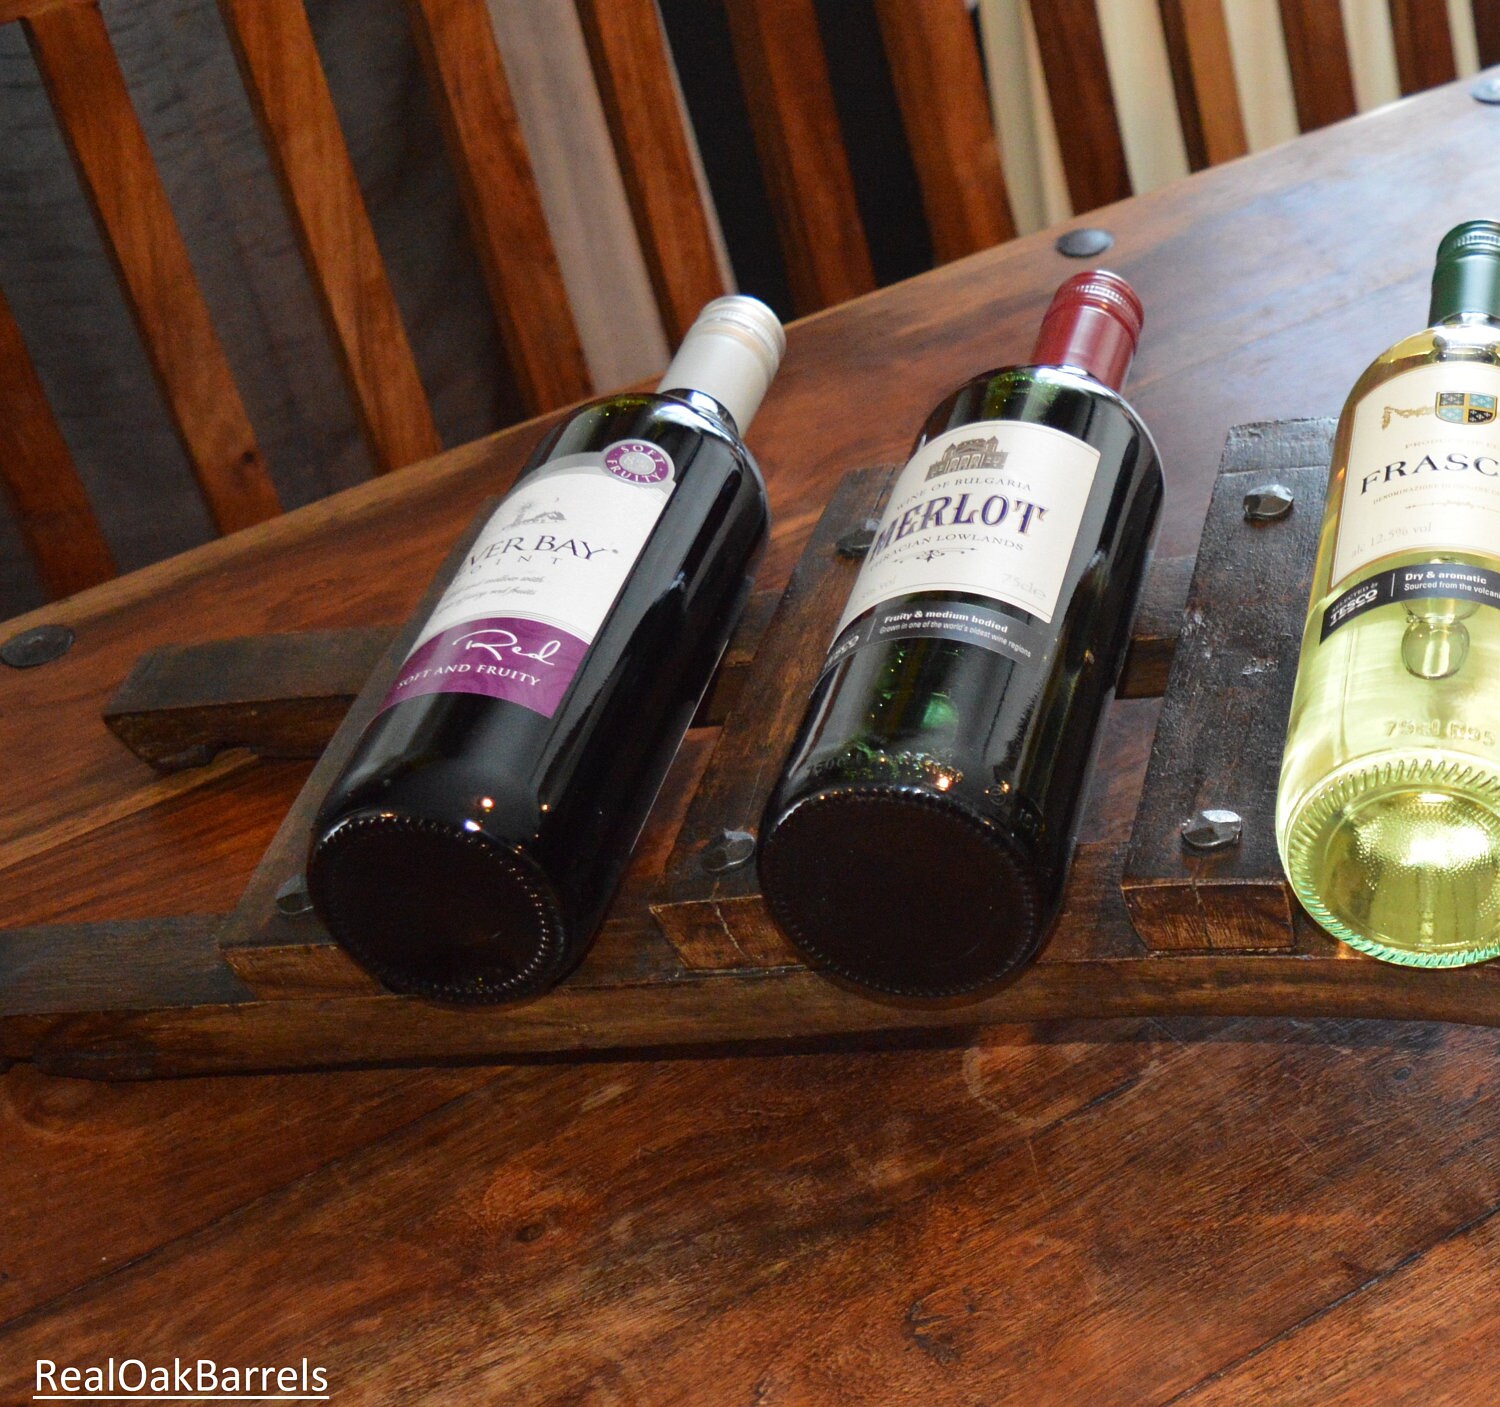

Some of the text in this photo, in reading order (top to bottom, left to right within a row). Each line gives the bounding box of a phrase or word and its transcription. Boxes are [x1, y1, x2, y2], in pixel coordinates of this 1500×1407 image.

[621, 444, 666, 466] SOFT
[606, 459, 662, 483] FRUITY
[897, 477, 1032, 511] WINE OF BULGARIA
[869, 493, 1050, 564] MERLOT
[936, 533, 1024, 551] LOWLANDS
[1404, 581, 1437, 591] Sourced
[1439, 580, 1457, 589] from
[1459, 582, 1472, 591] the
[1405, 570, 1487, 585] Dry & aromatic
[1330, 589, 1378, 625] TESCO
[884, 610, 1008, 633] Fruity & medium bodied
[453, 629, 561, 667] Red
[922, 620, 930, 628] of
[943, 622, 968, 633] world's
[969, 626, 991, 638] oldest
[991, 633, 1008, 644] wine
[1008, 639, 1032, 658] regions
[396, 663, 541, 690] SOFT AND FRUITY
